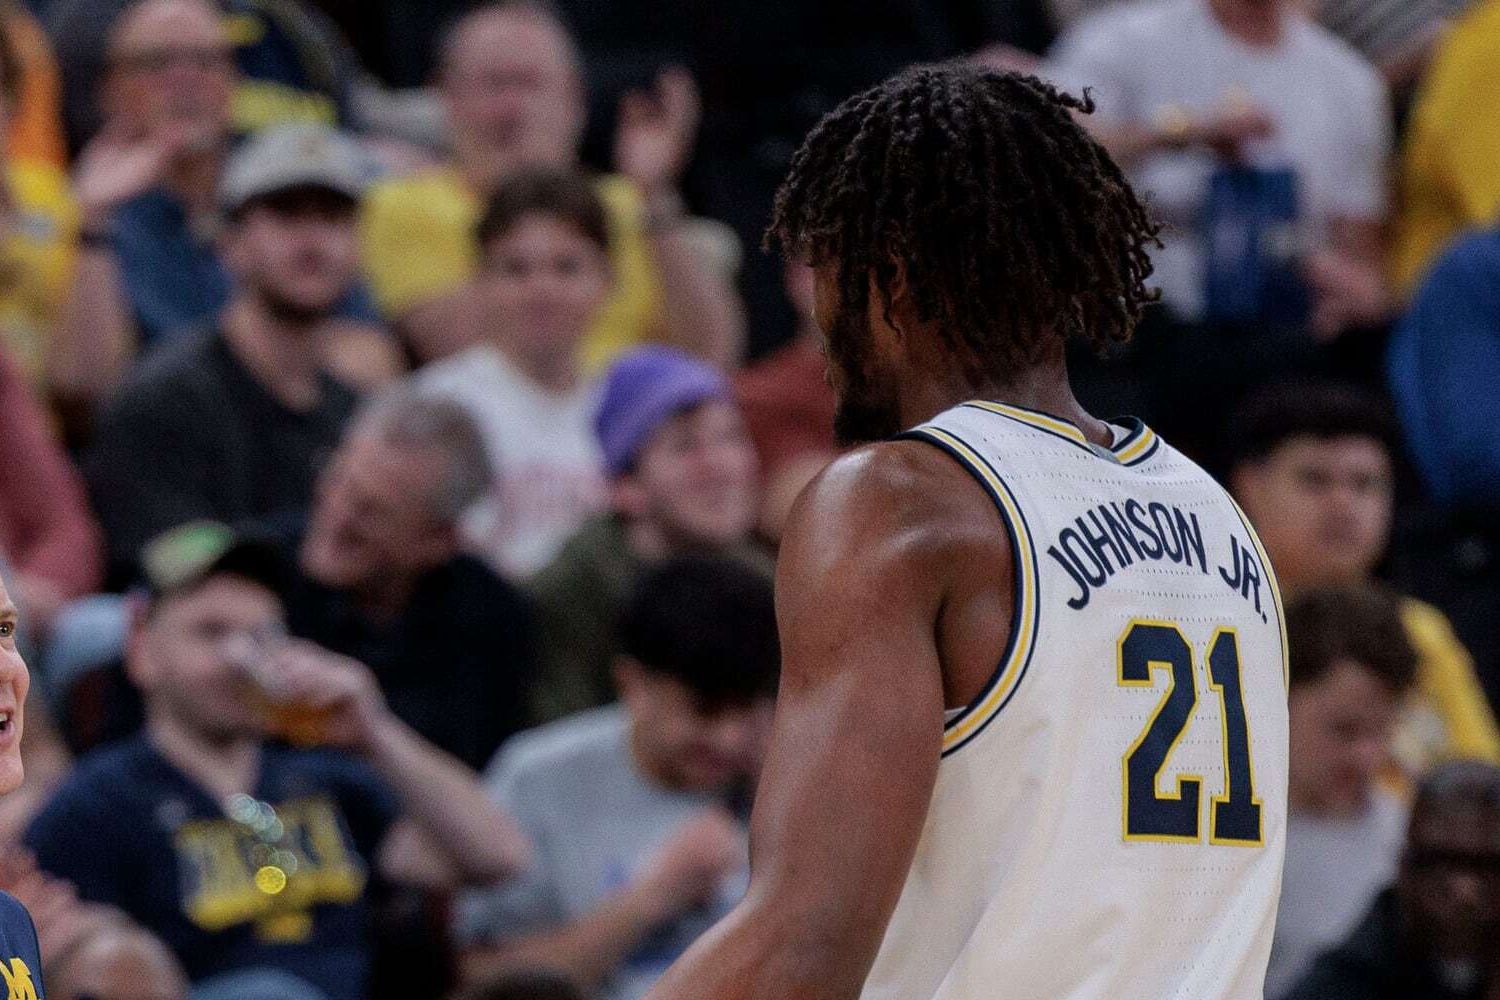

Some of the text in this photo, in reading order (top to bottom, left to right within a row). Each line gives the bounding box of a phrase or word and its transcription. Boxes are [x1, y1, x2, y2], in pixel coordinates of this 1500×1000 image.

[1046, 498, 1268, 625] JOHNSON JR.
[1116, 618, 1266, 848] 21
